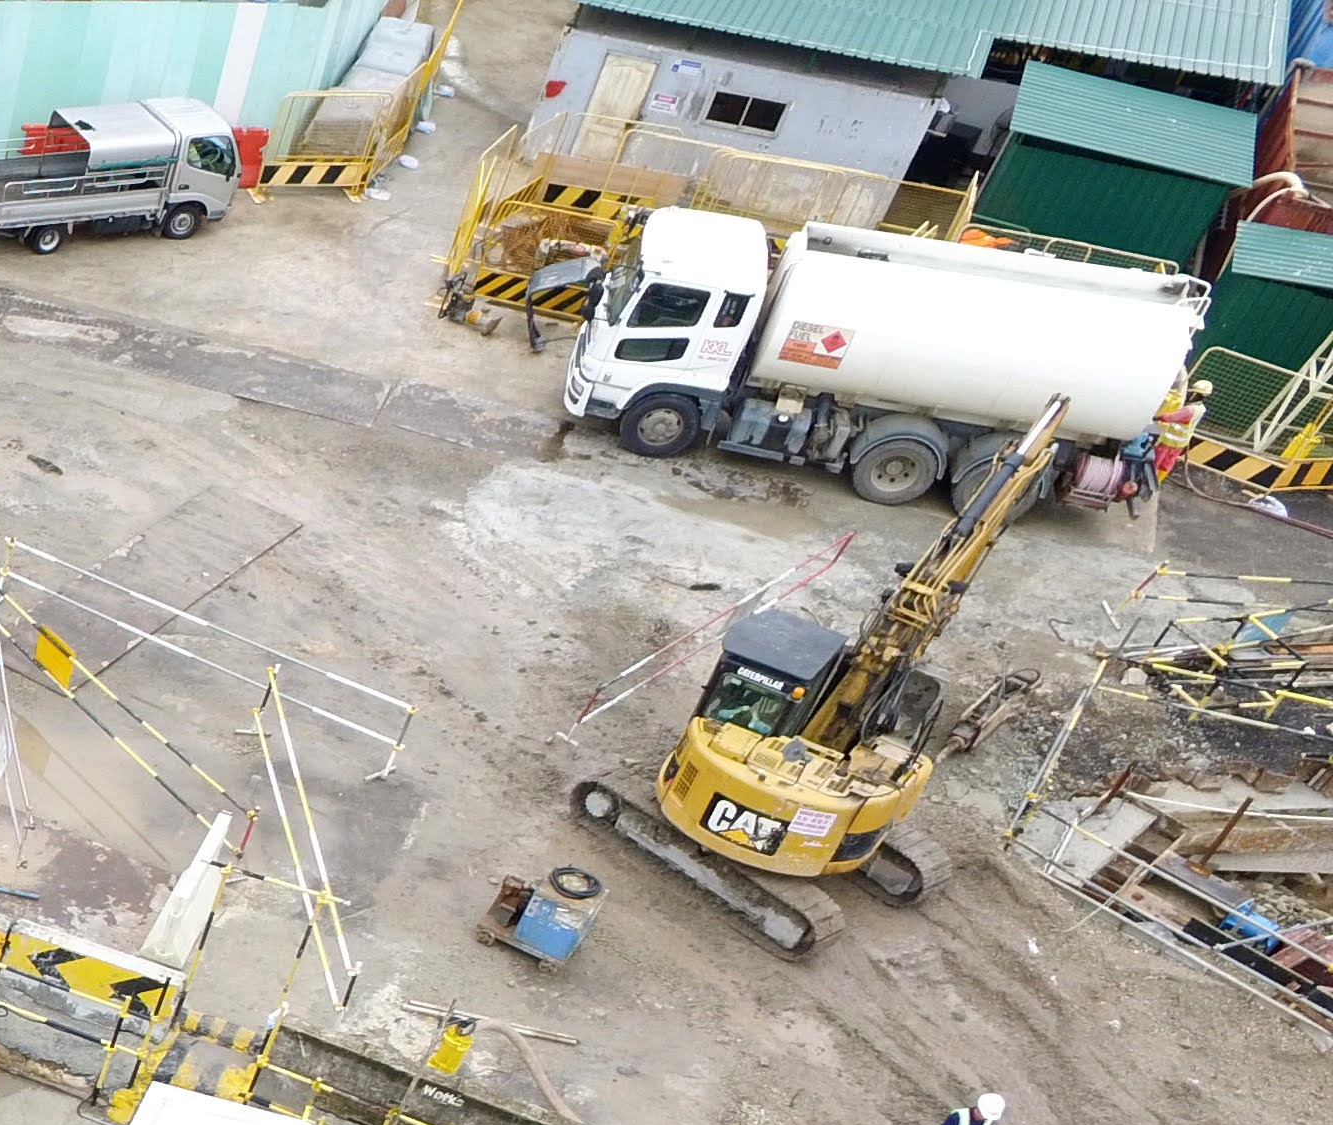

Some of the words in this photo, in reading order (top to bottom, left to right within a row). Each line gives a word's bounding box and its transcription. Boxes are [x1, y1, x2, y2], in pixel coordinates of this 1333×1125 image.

[789, 331, 813, 342] FUEL
[792, 320, 824, 334] DIESEL
[700, 338, 732, 357] KKL
[737, 666, 785, 691] CATERPILLAR
[707, 799, 783, 847] CAT
